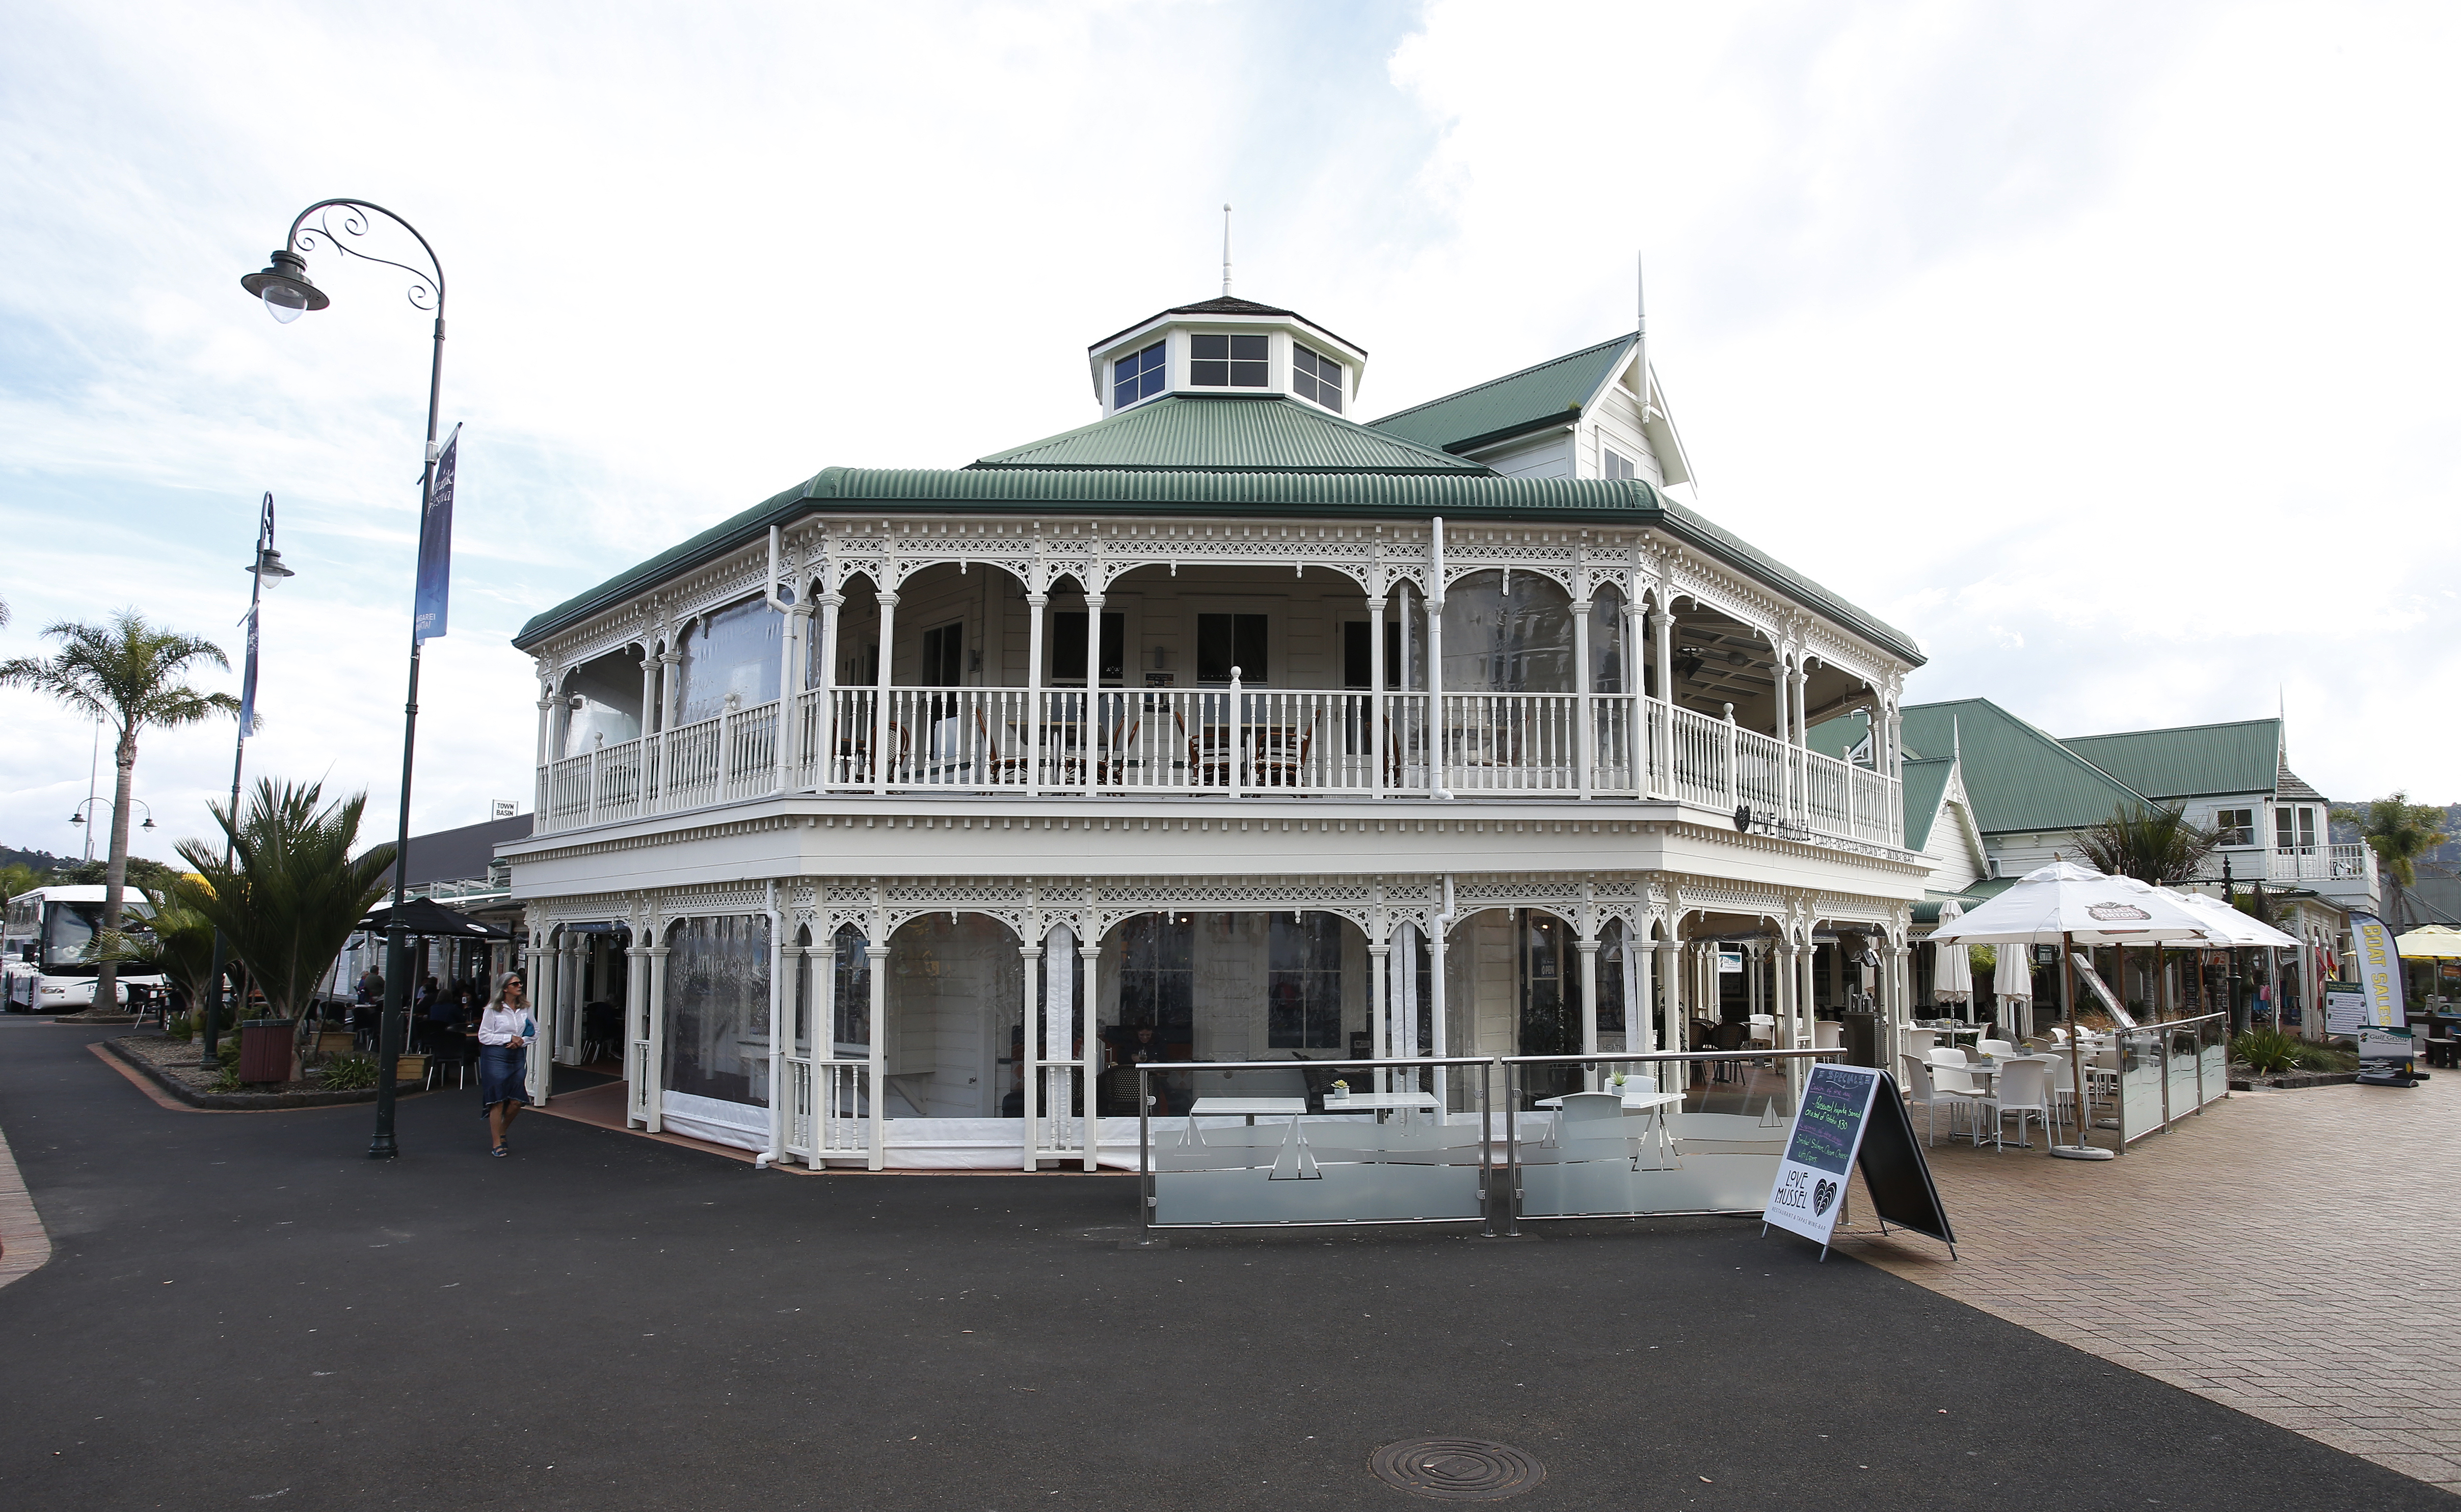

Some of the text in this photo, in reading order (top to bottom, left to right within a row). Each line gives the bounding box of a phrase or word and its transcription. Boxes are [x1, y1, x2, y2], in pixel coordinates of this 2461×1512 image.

[1753, 810, 1811, 841] LOVE MUSSEL
[1541, 965, 1555, 975] OPEN
[2362, 925, 2392, 1026] BOAT SALES
[1810, 1083, 1824, 1091] Catch
[1827, 1071, 1864, 1085] SPECIALS
[1837, 1119, 1848, 1130] $30
[1785, 1170, 1808, 1189] LOVE
[1774, 1186, 1808, 1209] MUSSEL
[1772, 1206, 1793, 1219] RESTAURANT
[1796, 1216, 1808, 1224] TAPAS
[1807, 1220, 1826, 1231] WINE-BAR
